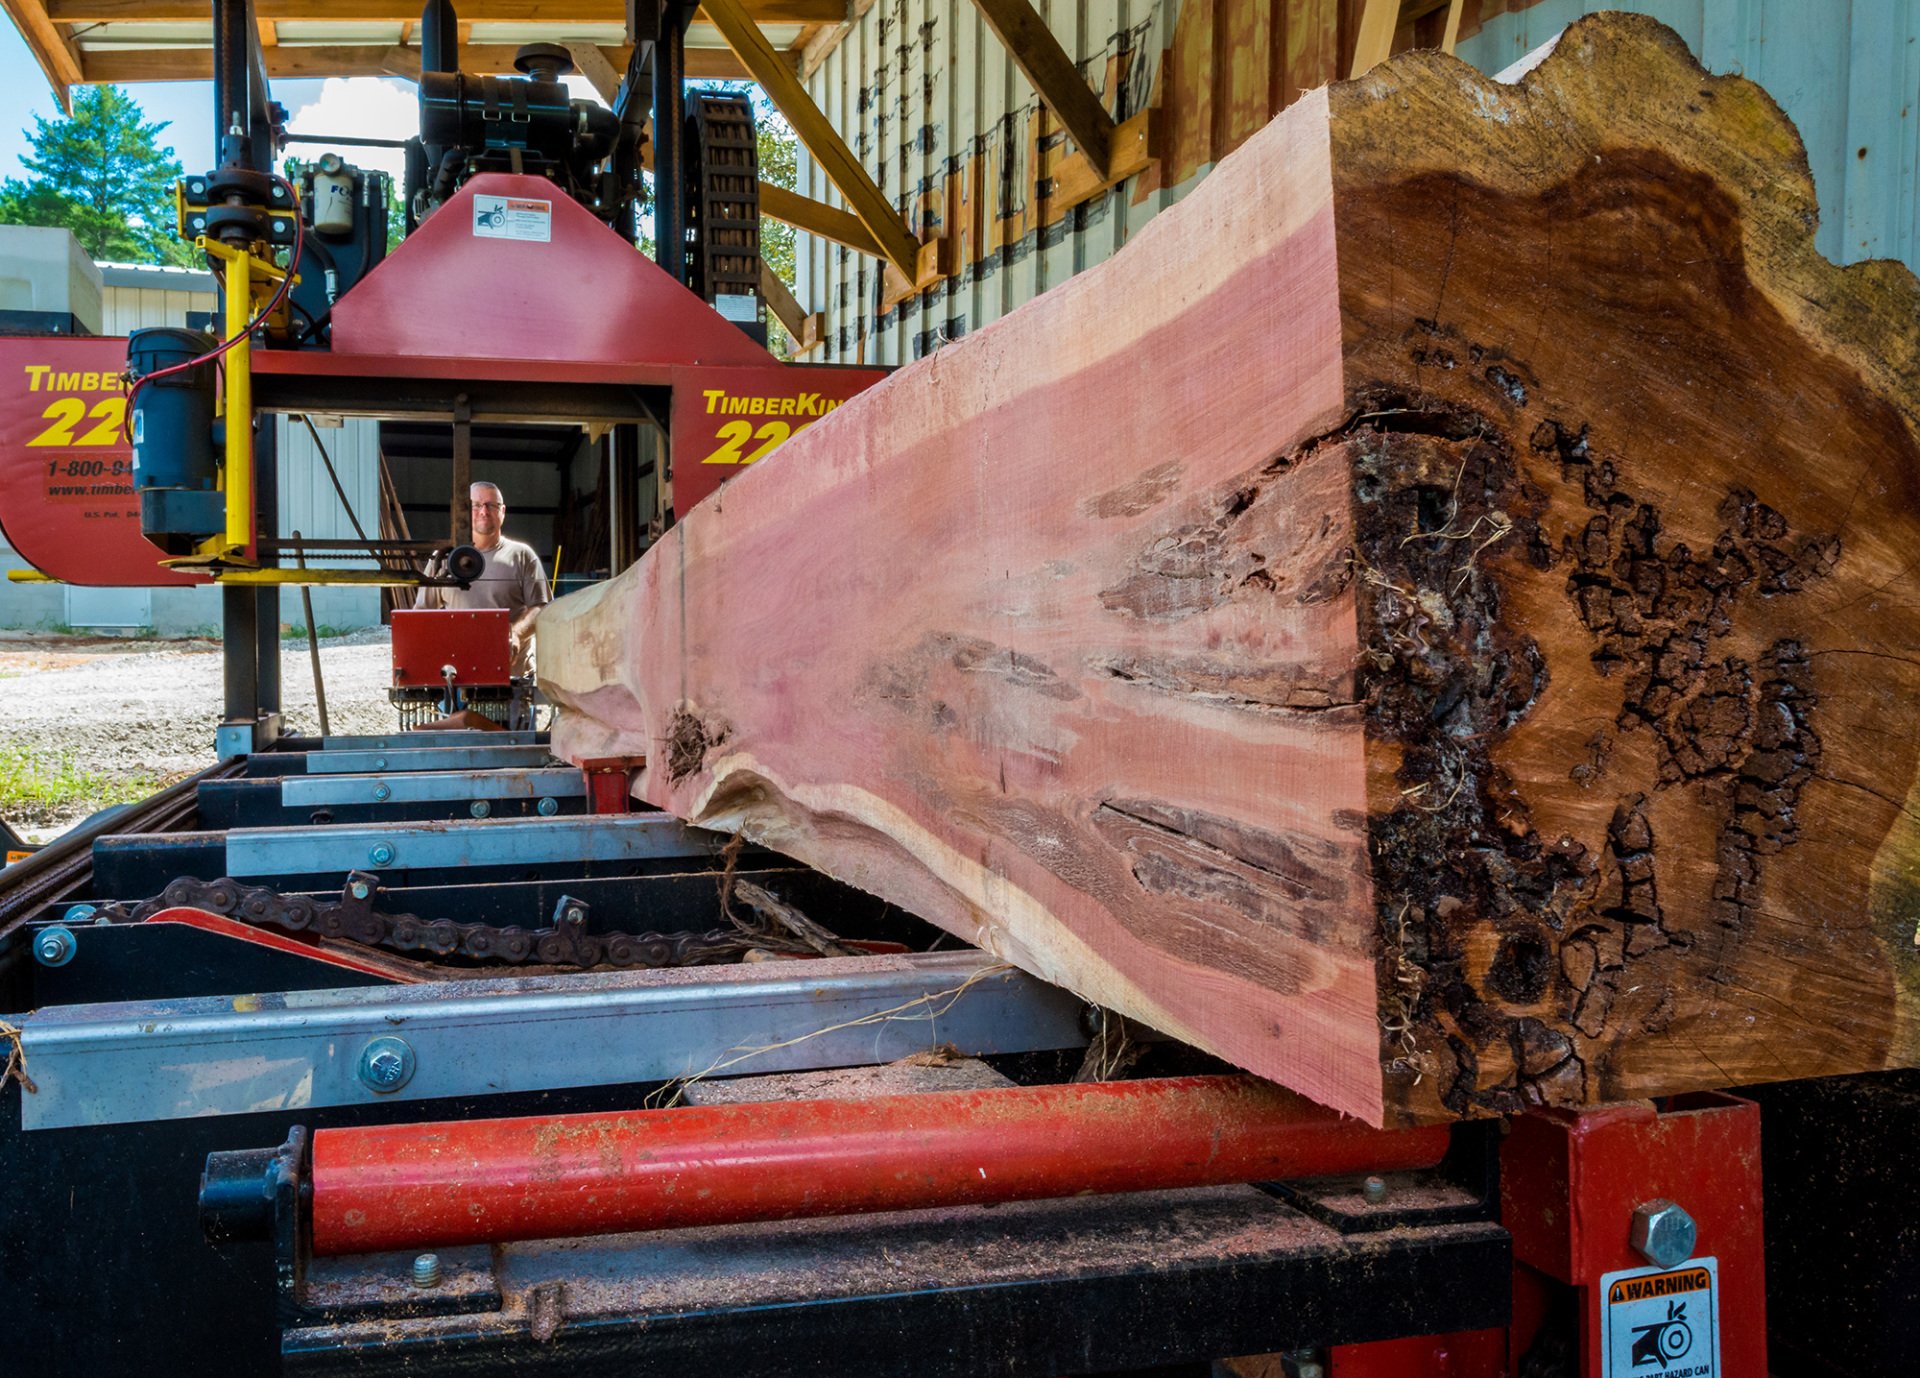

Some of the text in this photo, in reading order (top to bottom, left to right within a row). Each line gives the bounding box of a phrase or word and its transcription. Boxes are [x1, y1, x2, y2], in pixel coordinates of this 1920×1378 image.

[25, 397, 134, 447] 22
[701, 420, 814, 464] 22
[1626, 1272, 1706, 1300] WARNING
[1665, 1368, 1693, 1378] HAZARD
[1695, 1365, 1710, 1376] CAN
